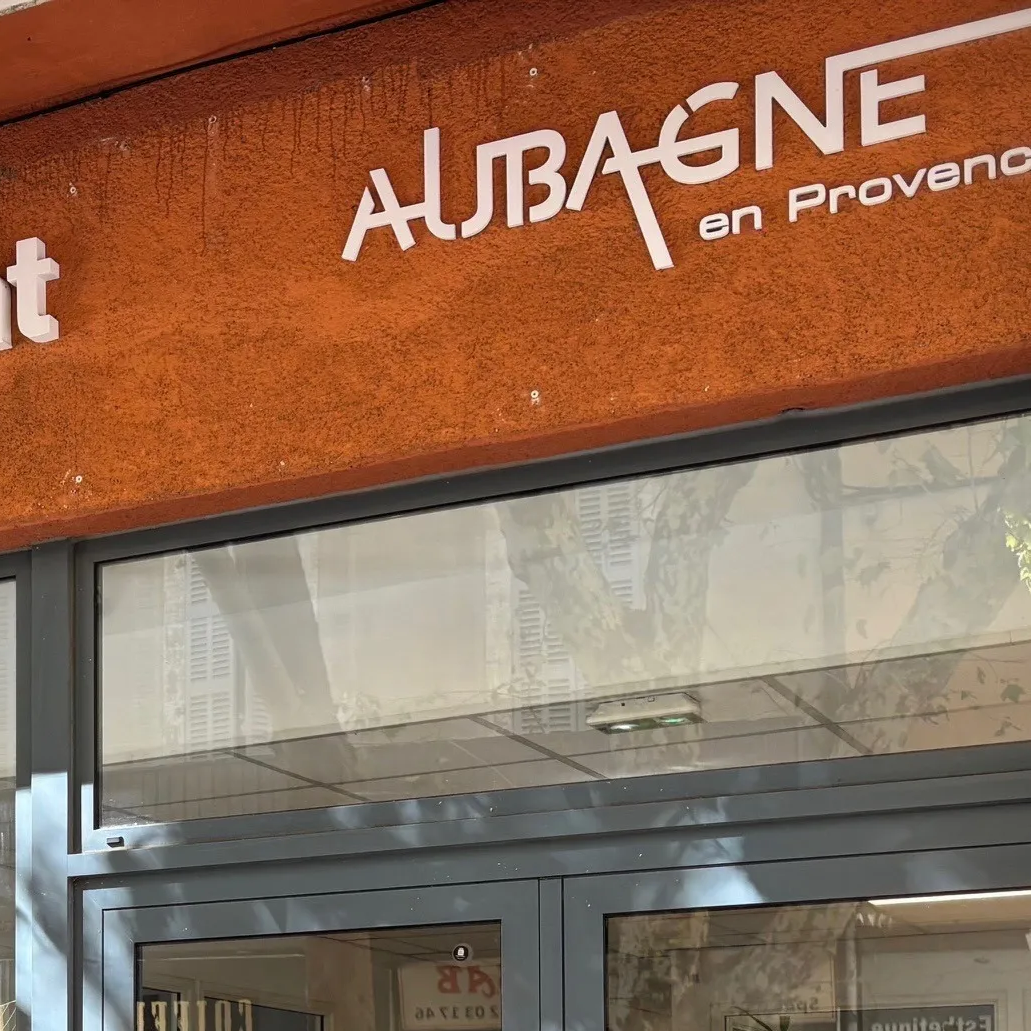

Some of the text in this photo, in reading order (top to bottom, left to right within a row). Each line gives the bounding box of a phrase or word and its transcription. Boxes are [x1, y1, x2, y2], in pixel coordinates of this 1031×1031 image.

[342, 56, 926, 270] AUBAGNE
[699, 146, 1031, 240] en Provenc
